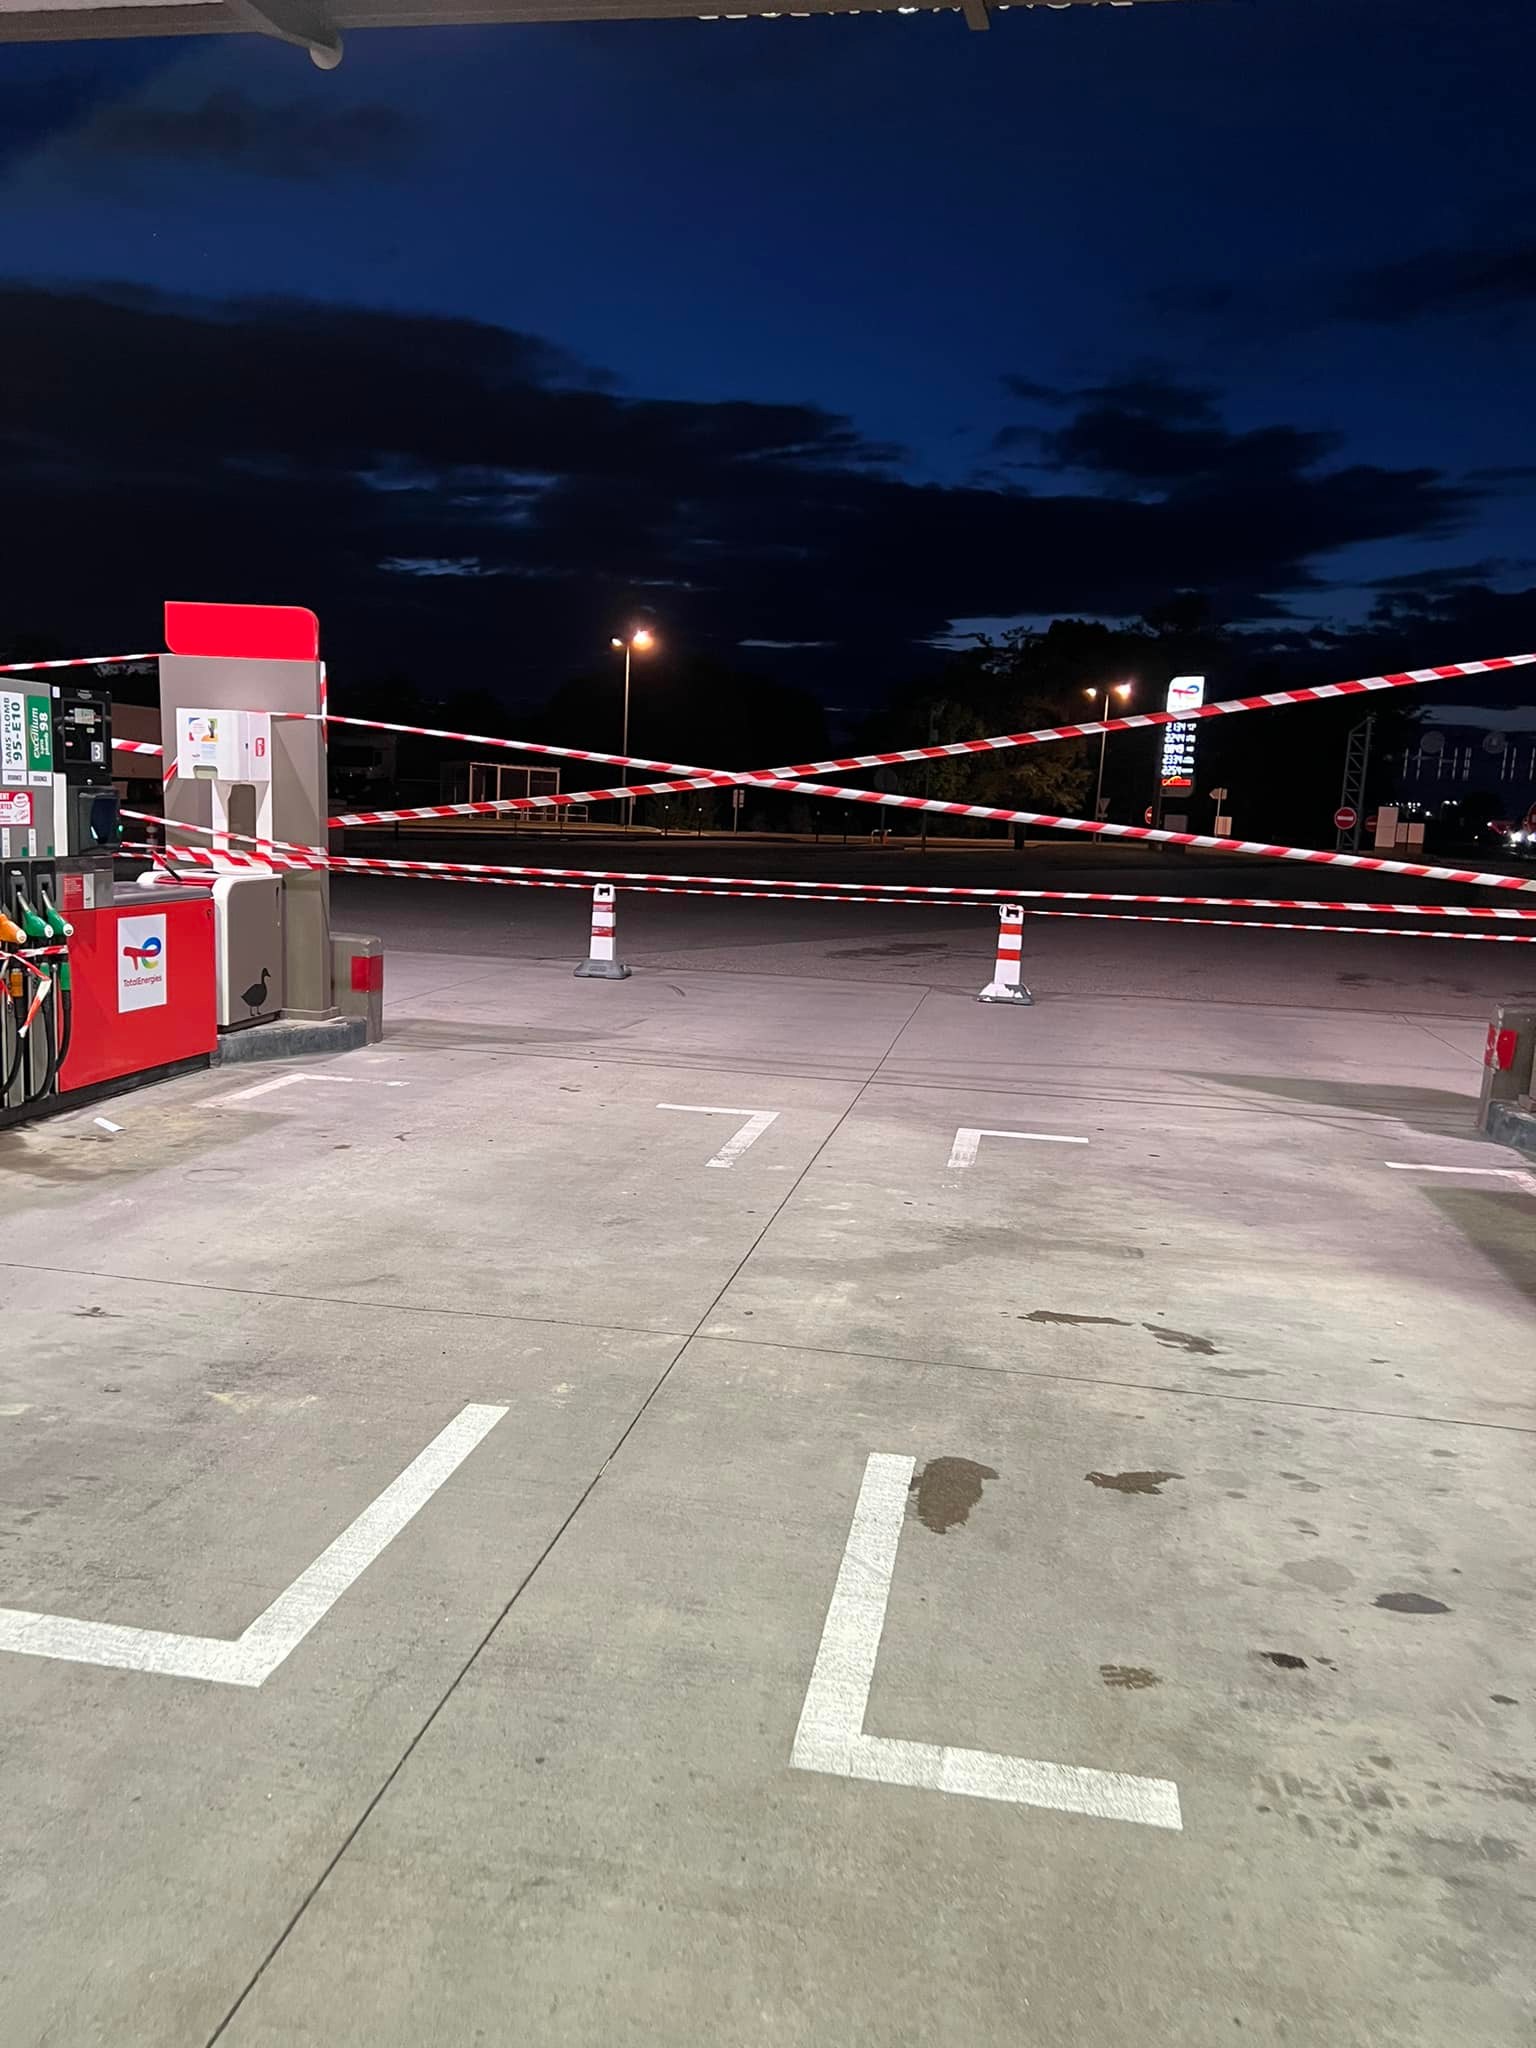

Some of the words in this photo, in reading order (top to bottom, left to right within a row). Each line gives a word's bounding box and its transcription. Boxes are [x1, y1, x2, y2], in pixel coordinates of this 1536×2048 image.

[11, 702, 22, 760] 95-E10
[39, 712, 48, 731] 98
[31, 707, 40, 758] excellium
[94, 744, 101, 760] 3
[123, 976, 162, 987] TotalEnergies
